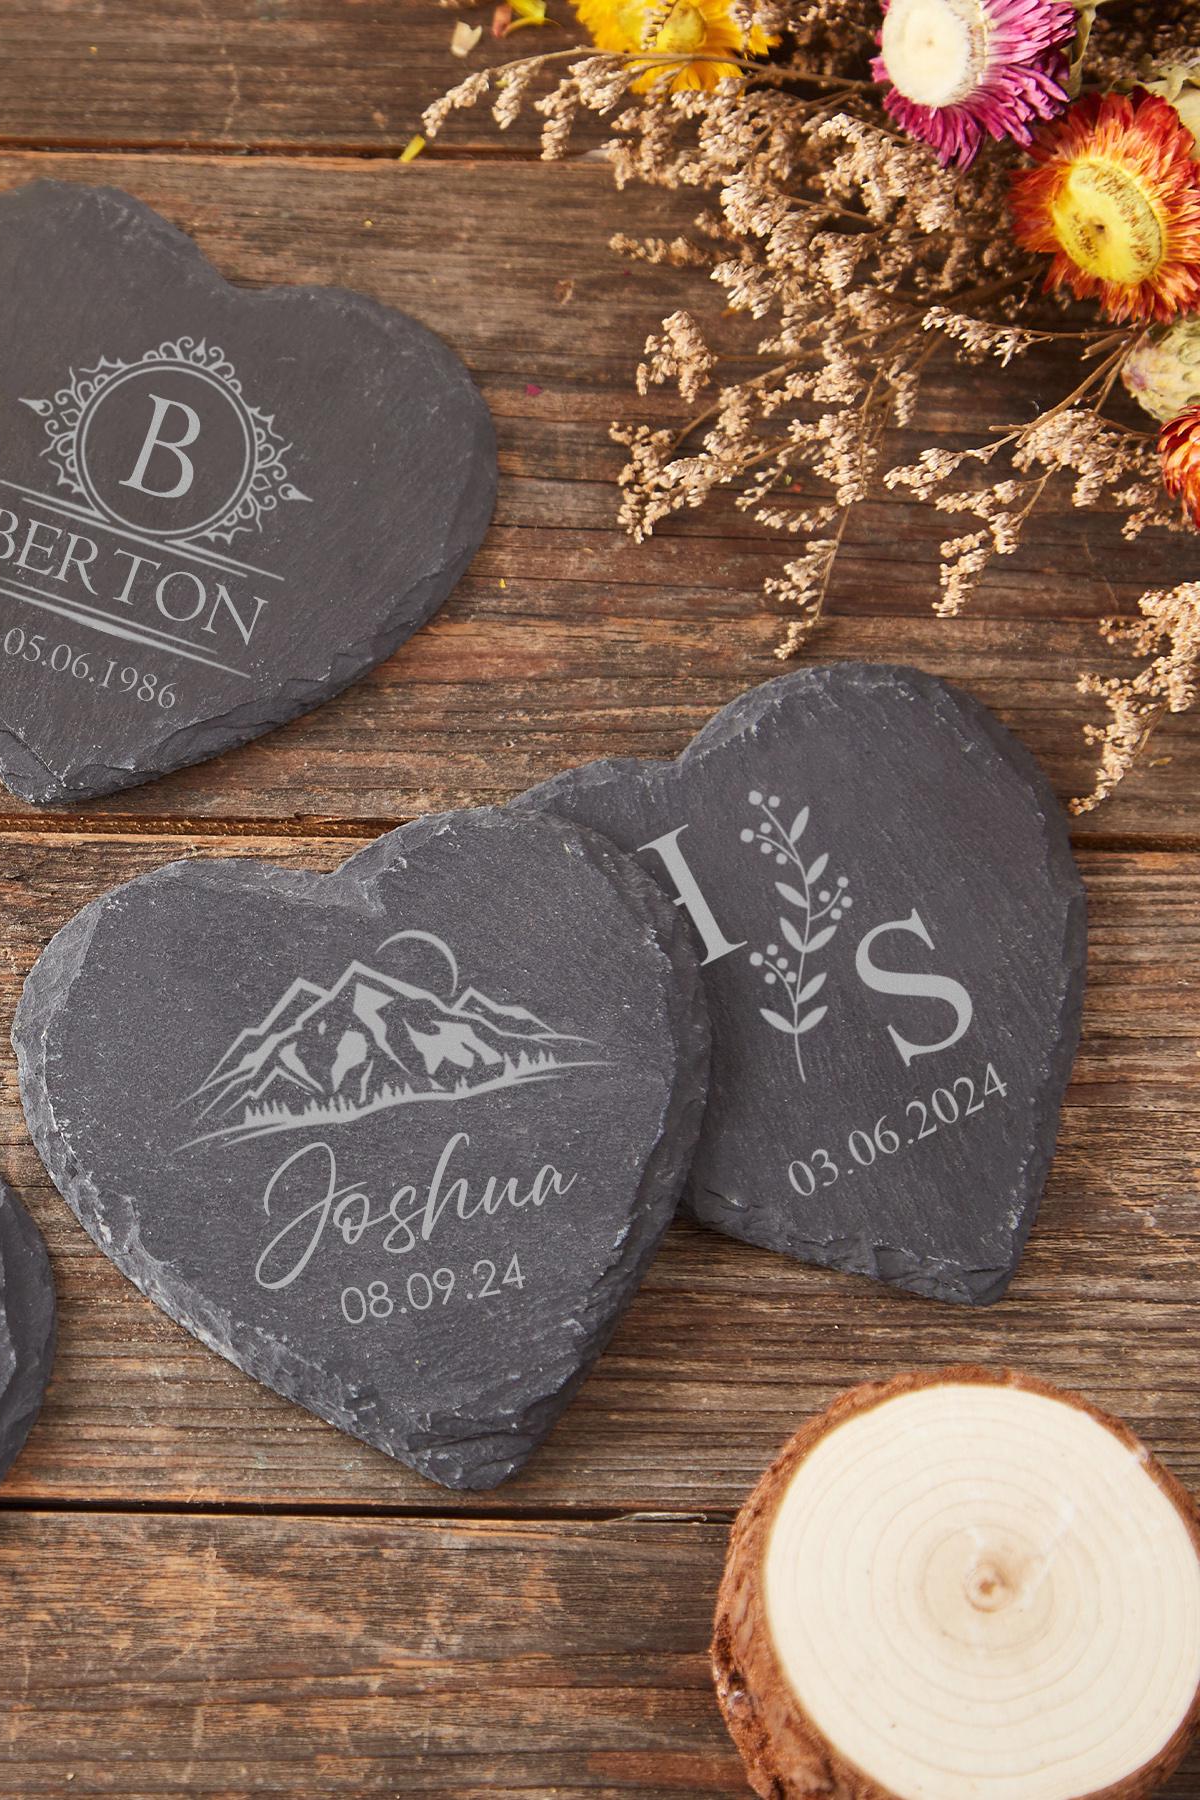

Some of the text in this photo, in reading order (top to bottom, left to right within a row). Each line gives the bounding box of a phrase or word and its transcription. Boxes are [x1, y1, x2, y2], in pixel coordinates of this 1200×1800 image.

[118, 393, 202, 498] B
[4, 628, 176, 709] 05.06.1986
[855, 908, 973, 1067] S
[788, 1063, 1008, 1197] 03.06.2024
[254, 1131, 578, 1290] Joshua
[341, 1253, 527, 1325] 08.09.24
